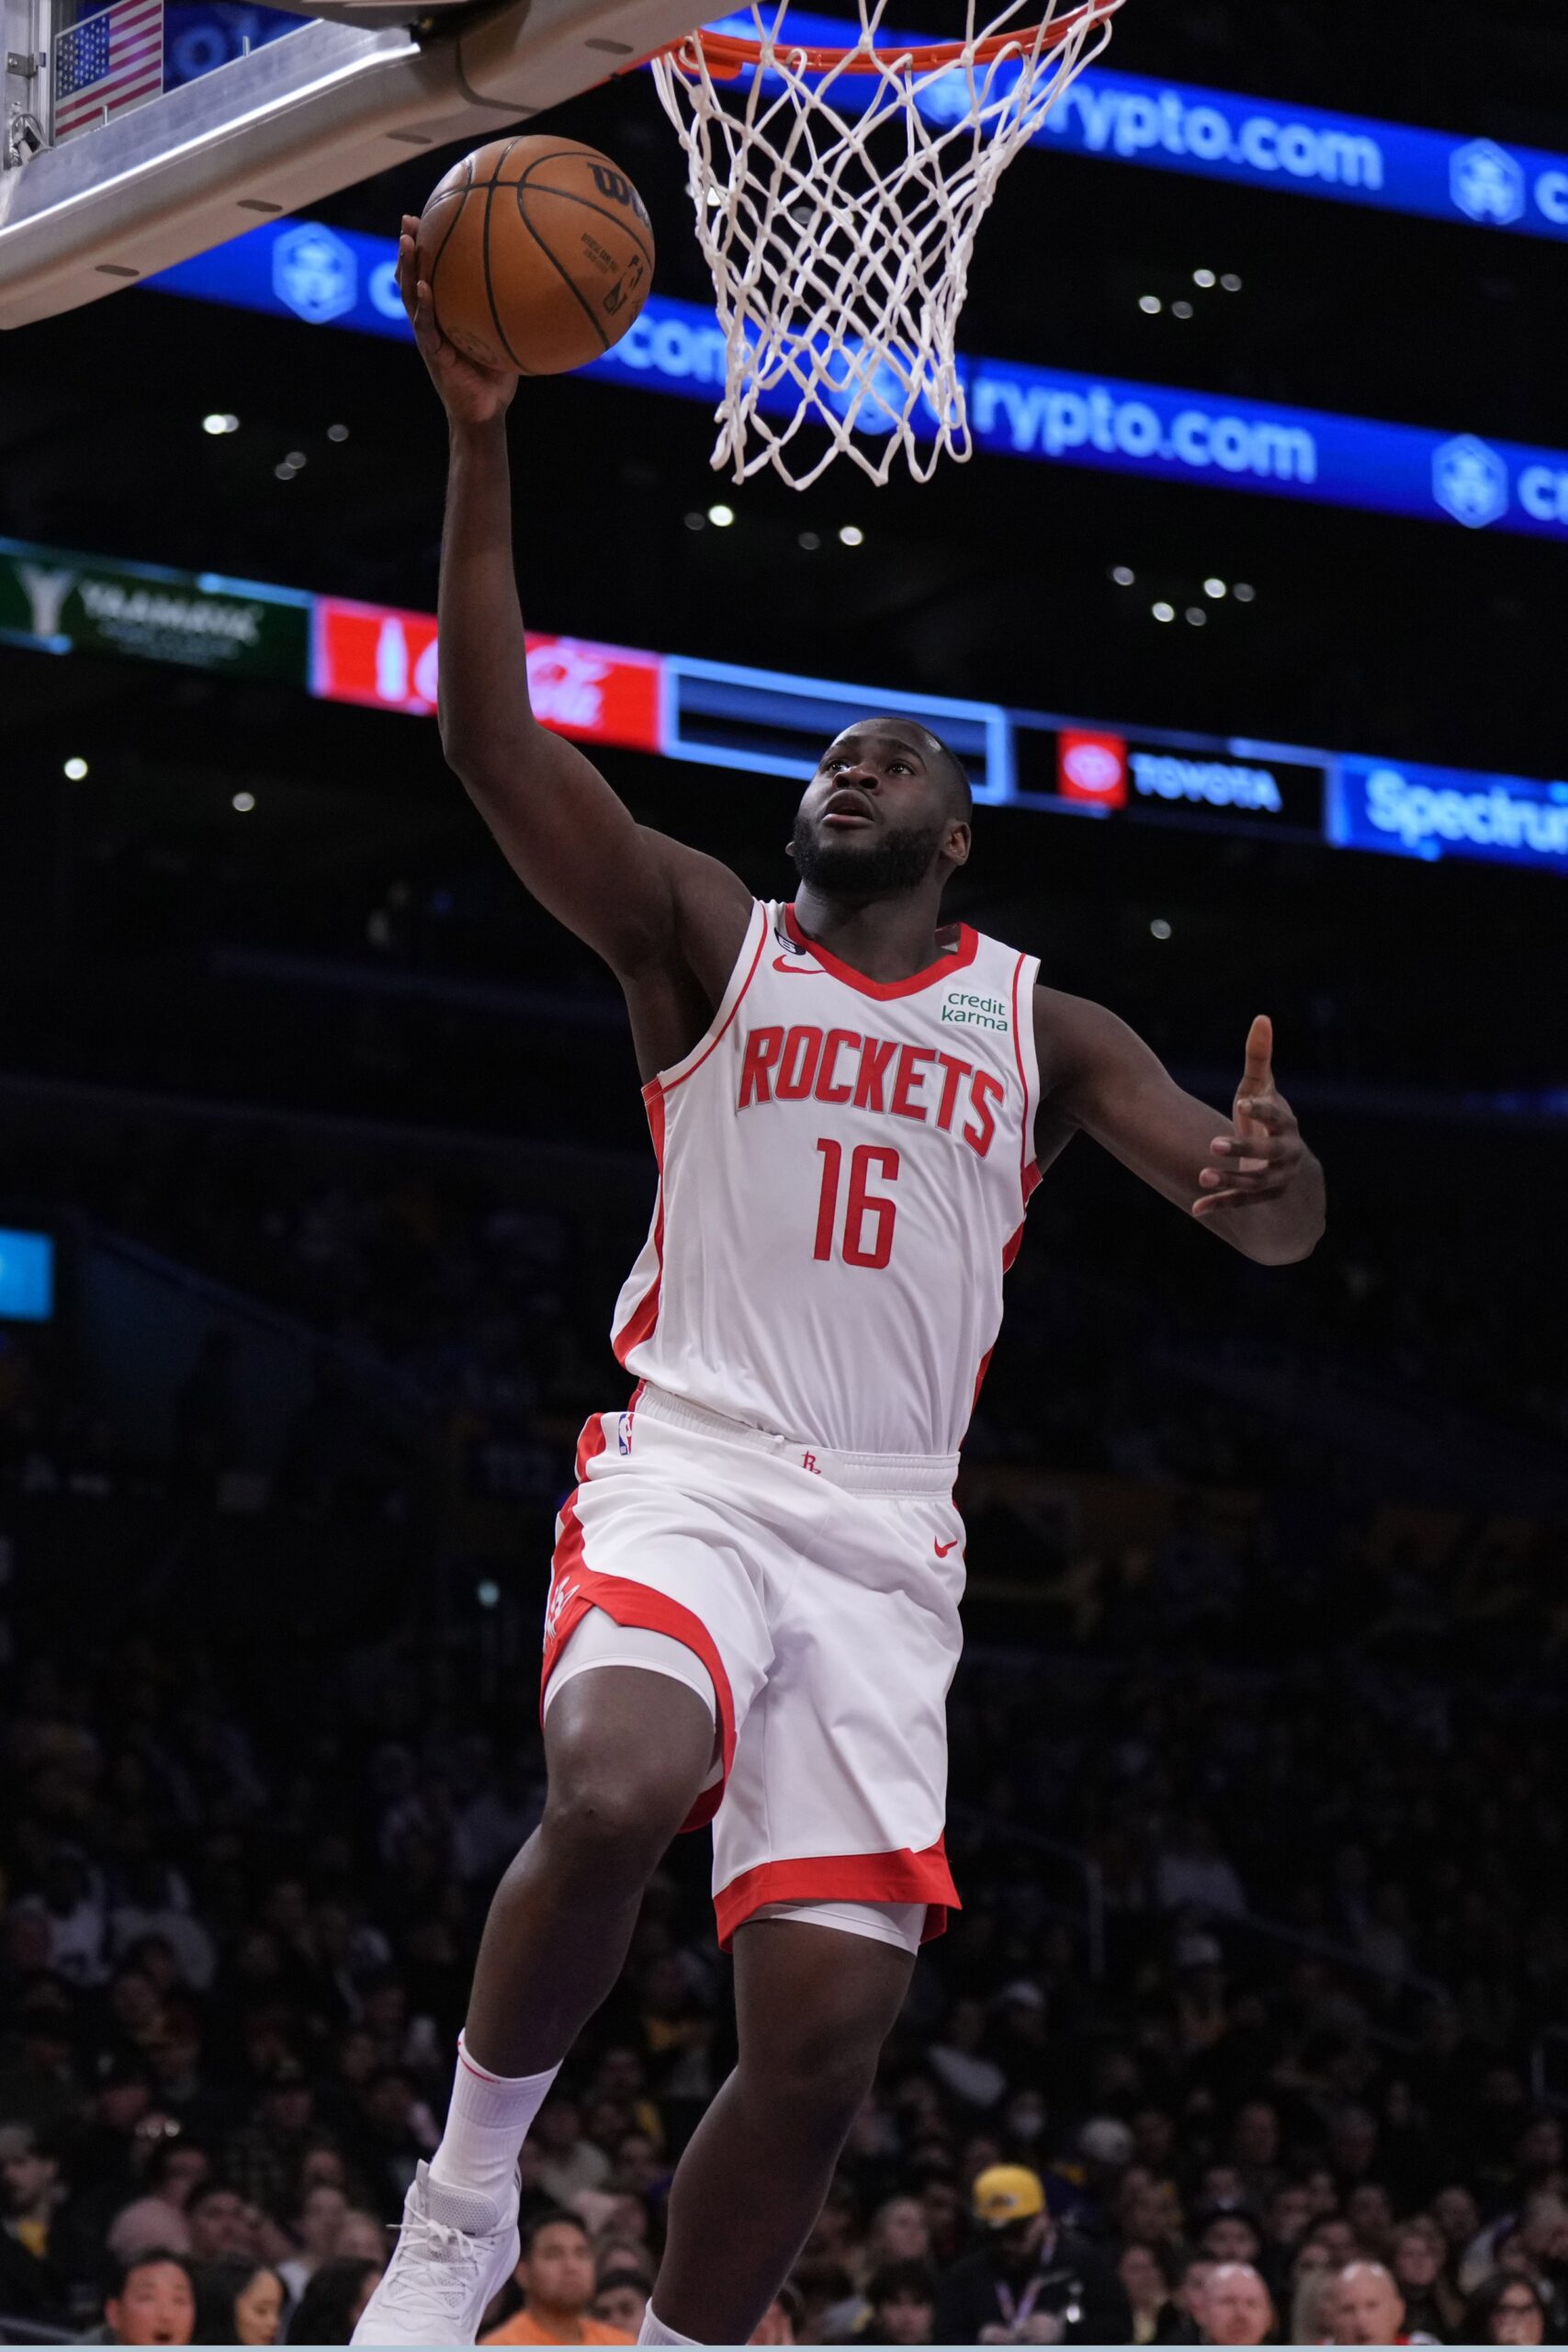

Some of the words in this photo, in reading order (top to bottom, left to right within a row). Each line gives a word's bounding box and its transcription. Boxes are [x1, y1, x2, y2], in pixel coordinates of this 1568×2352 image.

[1128, 752, 1283, 813] TOYOTA
[942, 1005, 1009, 1032] karma
[948, 992, 1006, 1016] credit
[736, 1024, 1005, 1160] ROCKETS
[813, 1137, 900, 1270] 16
